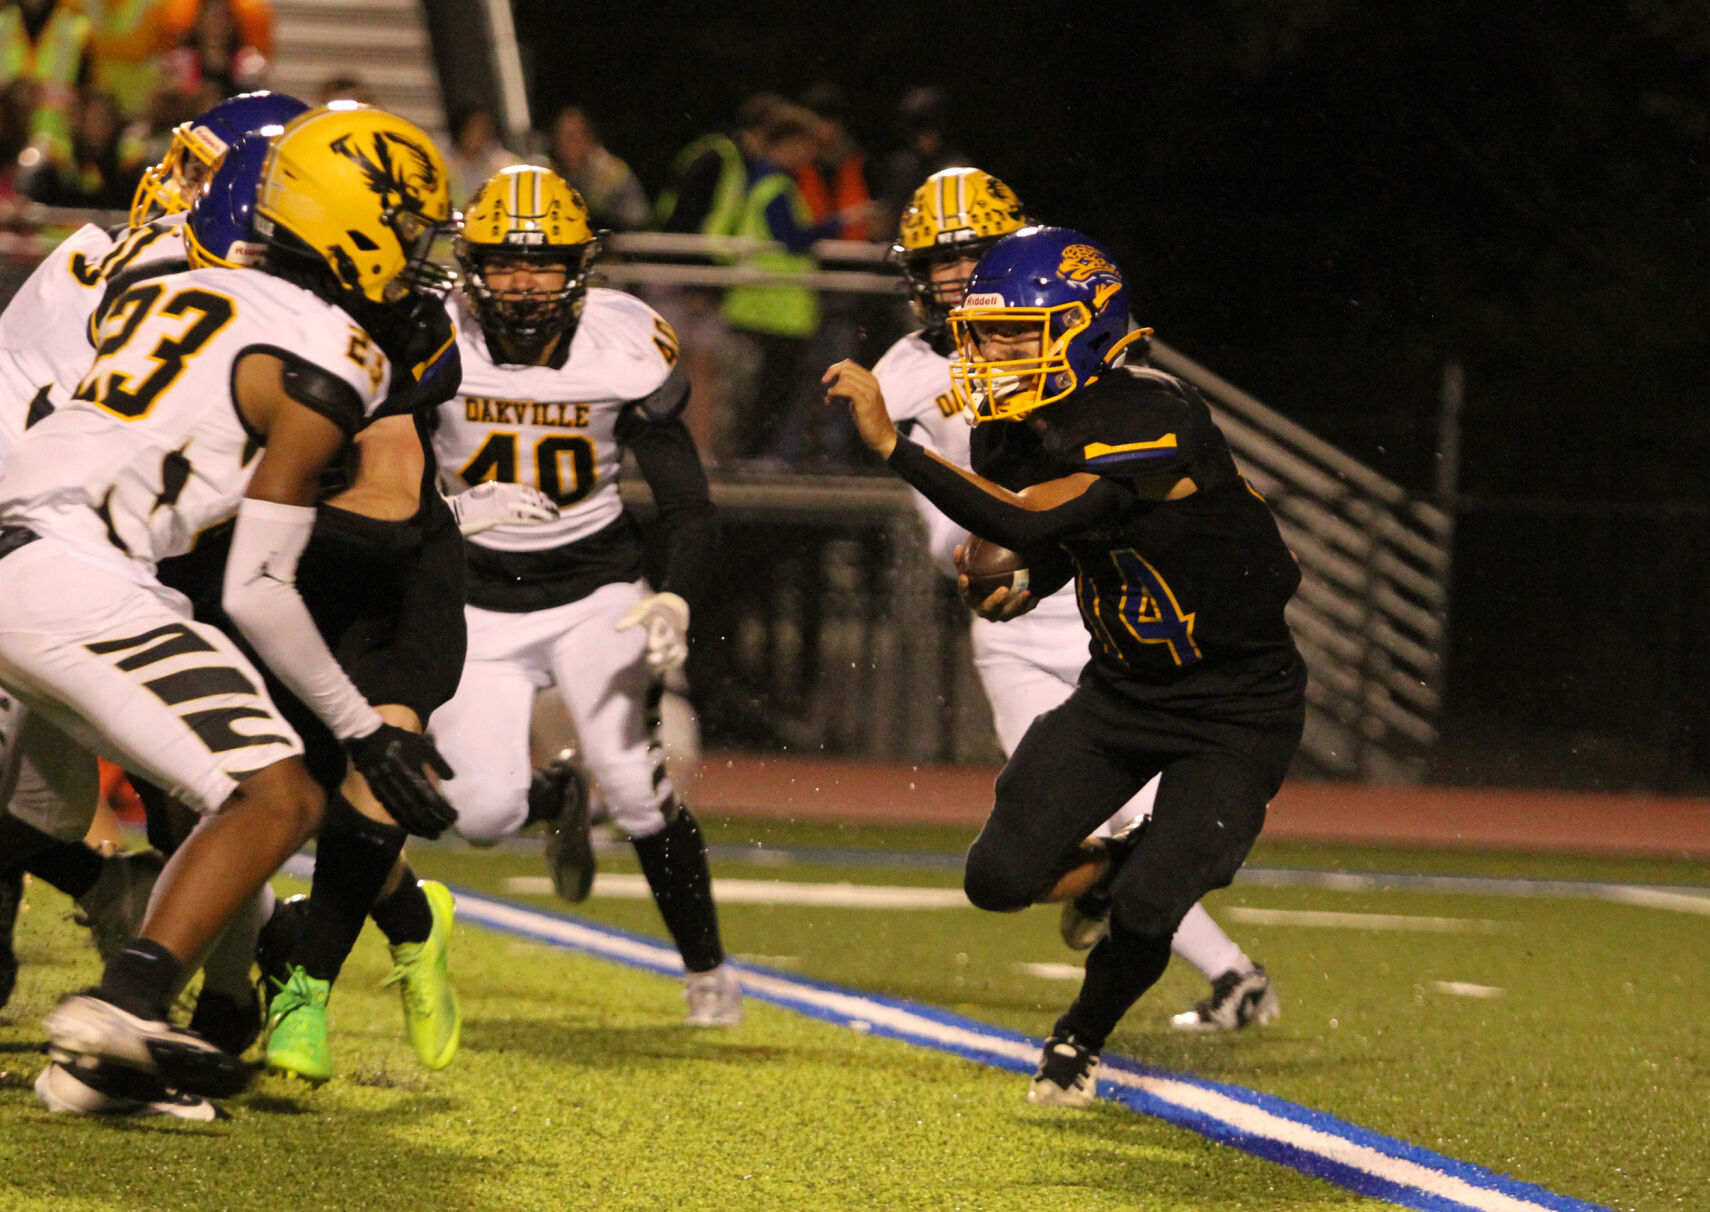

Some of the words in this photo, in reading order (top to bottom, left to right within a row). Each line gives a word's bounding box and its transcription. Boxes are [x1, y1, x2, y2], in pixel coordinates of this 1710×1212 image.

[966, 296, 998, 306] Riddell
[70, 281, 237, 422] 23
[465, 396, 592, 428] OAKVILLE
[456, 430, 598, 511] 40
[1059, 543, 1203, 667] 14
